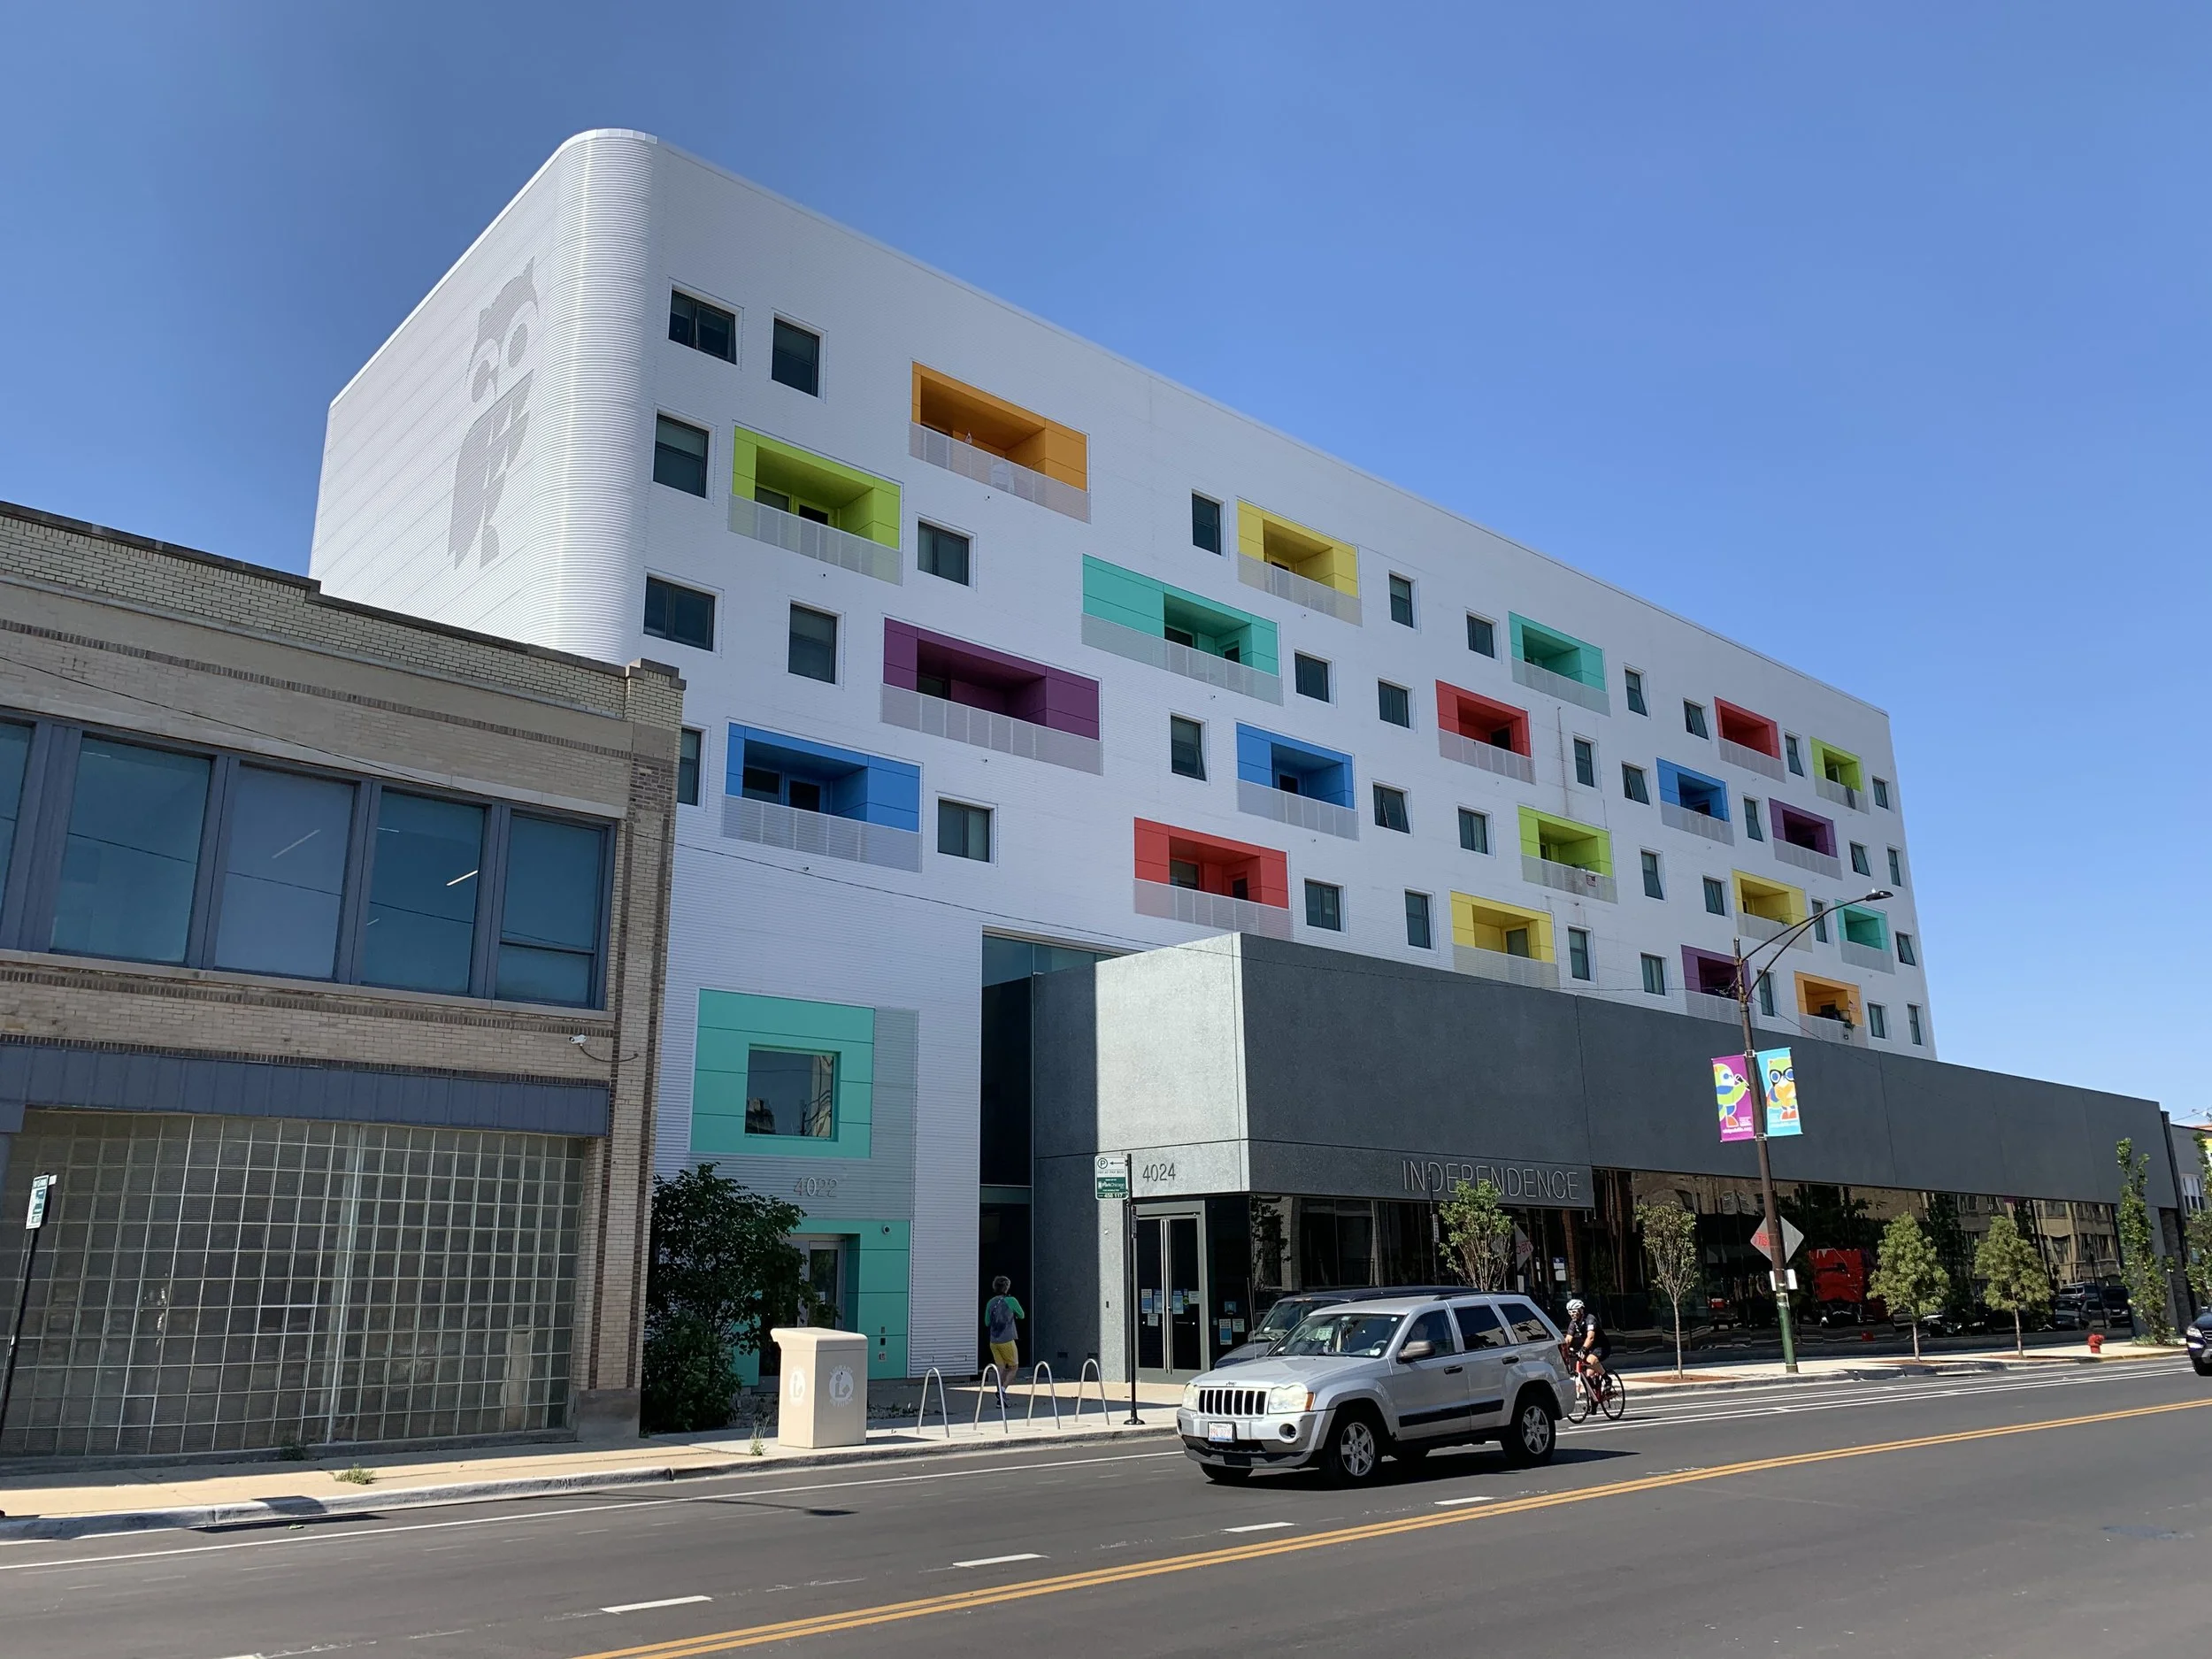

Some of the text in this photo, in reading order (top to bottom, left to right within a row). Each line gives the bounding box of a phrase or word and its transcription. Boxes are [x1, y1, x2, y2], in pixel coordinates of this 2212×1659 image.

[1142, 1163, 1176, 1182] 4024
[1402, 1160, 1579, 1200] INDEPENDENCE
[794, 1177, 839, 1197] 4022
